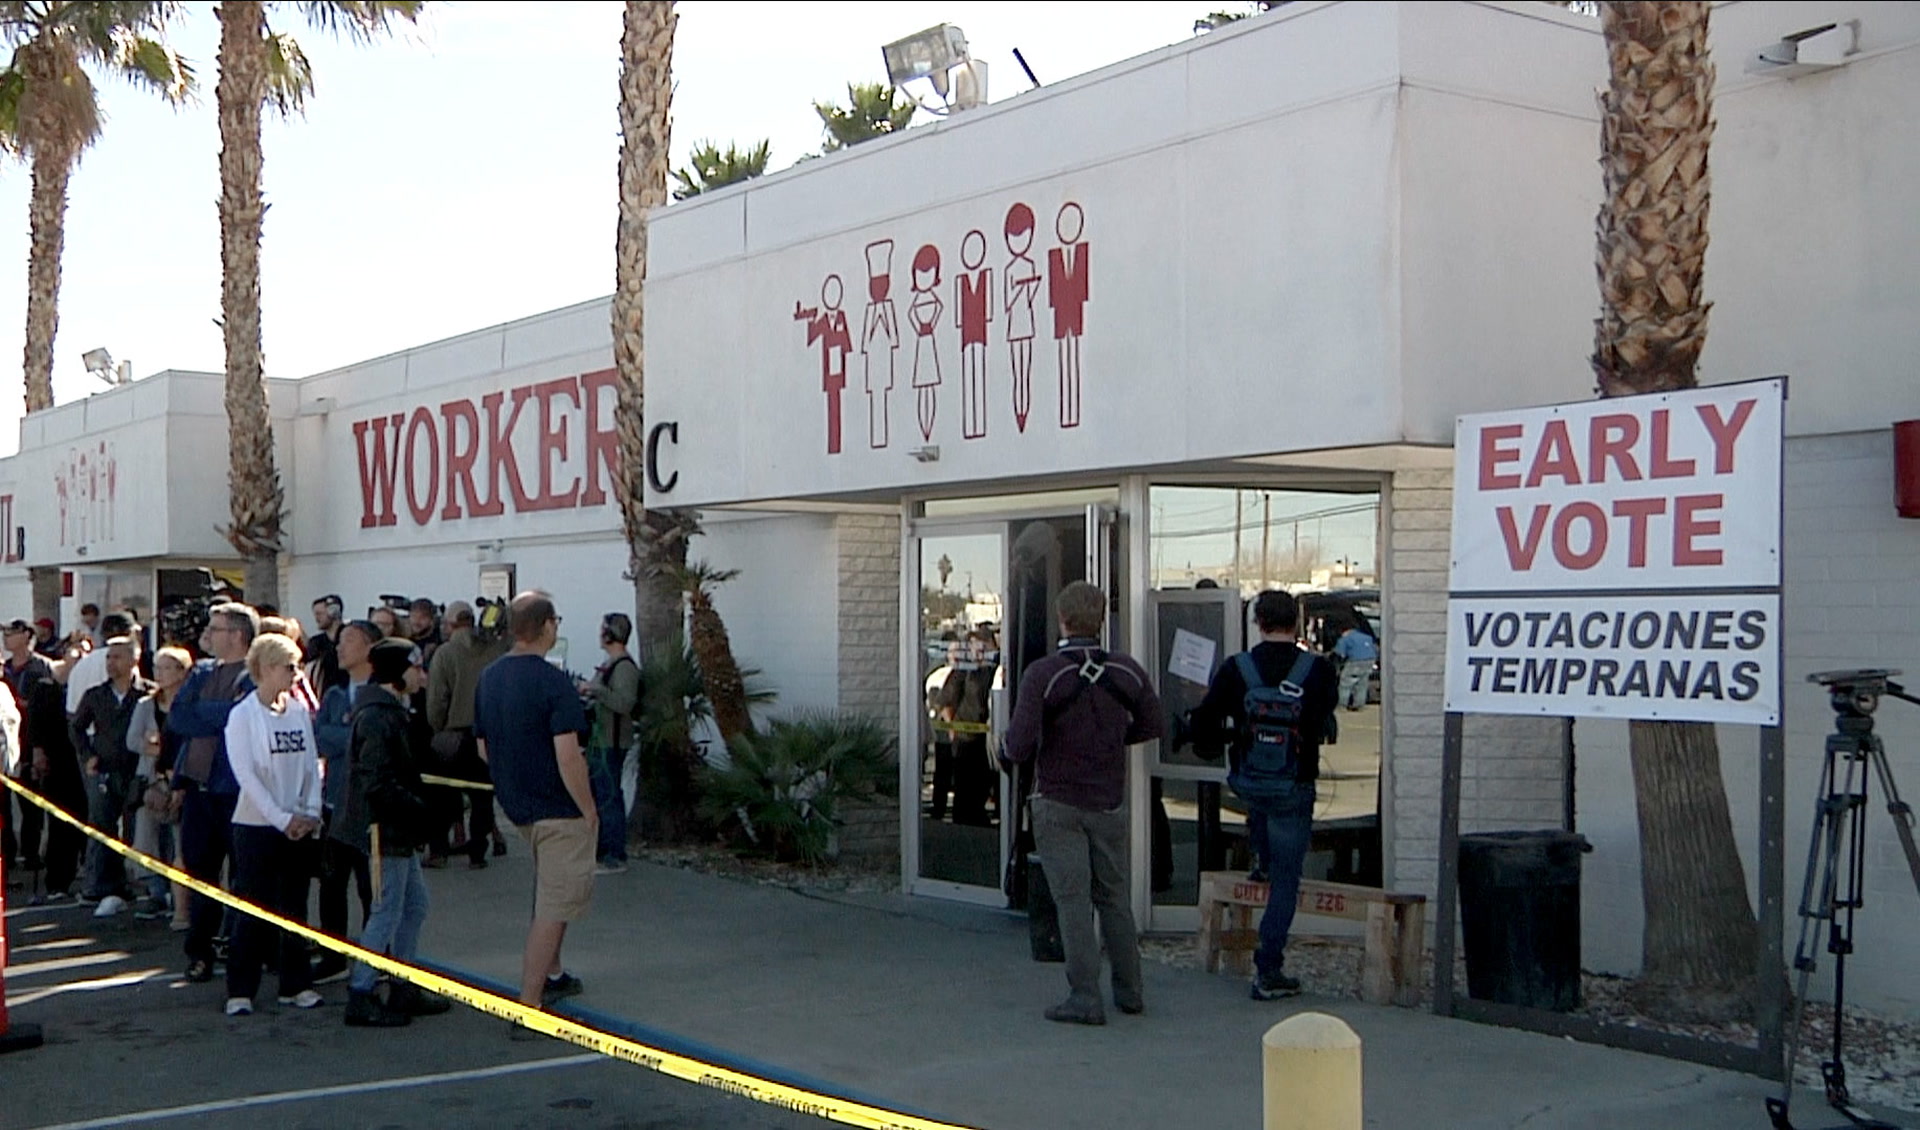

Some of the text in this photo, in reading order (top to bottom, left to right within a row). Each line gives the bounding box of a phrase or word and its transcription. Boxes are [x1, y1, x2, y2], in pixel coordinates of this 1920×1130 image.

[647, 421, 678, 493] C
[1478, 399, 1757, 490] EARLY
[1495, 493, 1723, 571] VOTE
[1465, 610, 1767, 650] VOTACIONES
[1468, 657, 1761, 701] TEMPRANAS
[1316, 891, 1345, 912] 226
